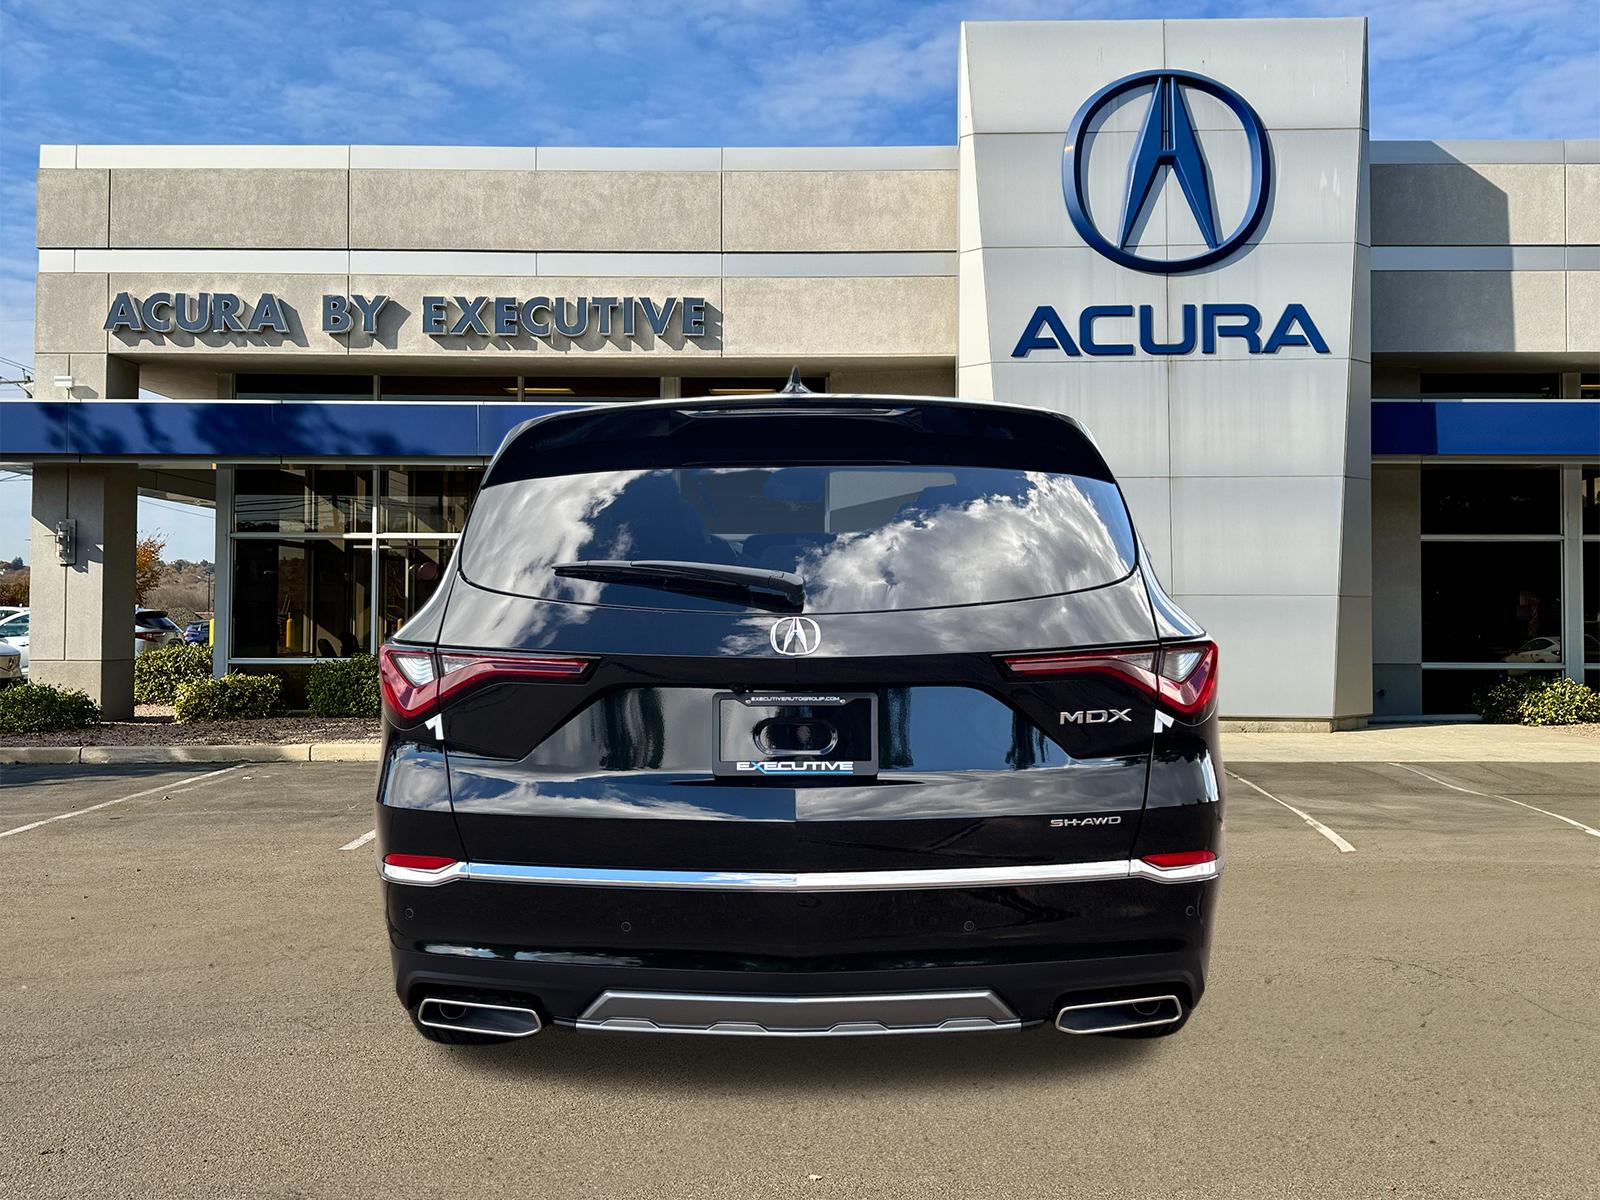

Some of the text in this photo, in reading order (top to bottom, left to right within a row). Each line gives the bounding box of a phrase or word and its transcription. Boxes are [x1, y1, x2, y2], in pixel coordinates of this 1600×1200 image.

[103, 291, 706, 337] ACURA BY EXECUTIVE
[1010, 303, 1332, 357] ACURA
[1059, 708, 1133, 725] MDX
[736, 761, 854, 774] EXECUTIVE
[1050, 816, 1122, 827] SH-AWD
